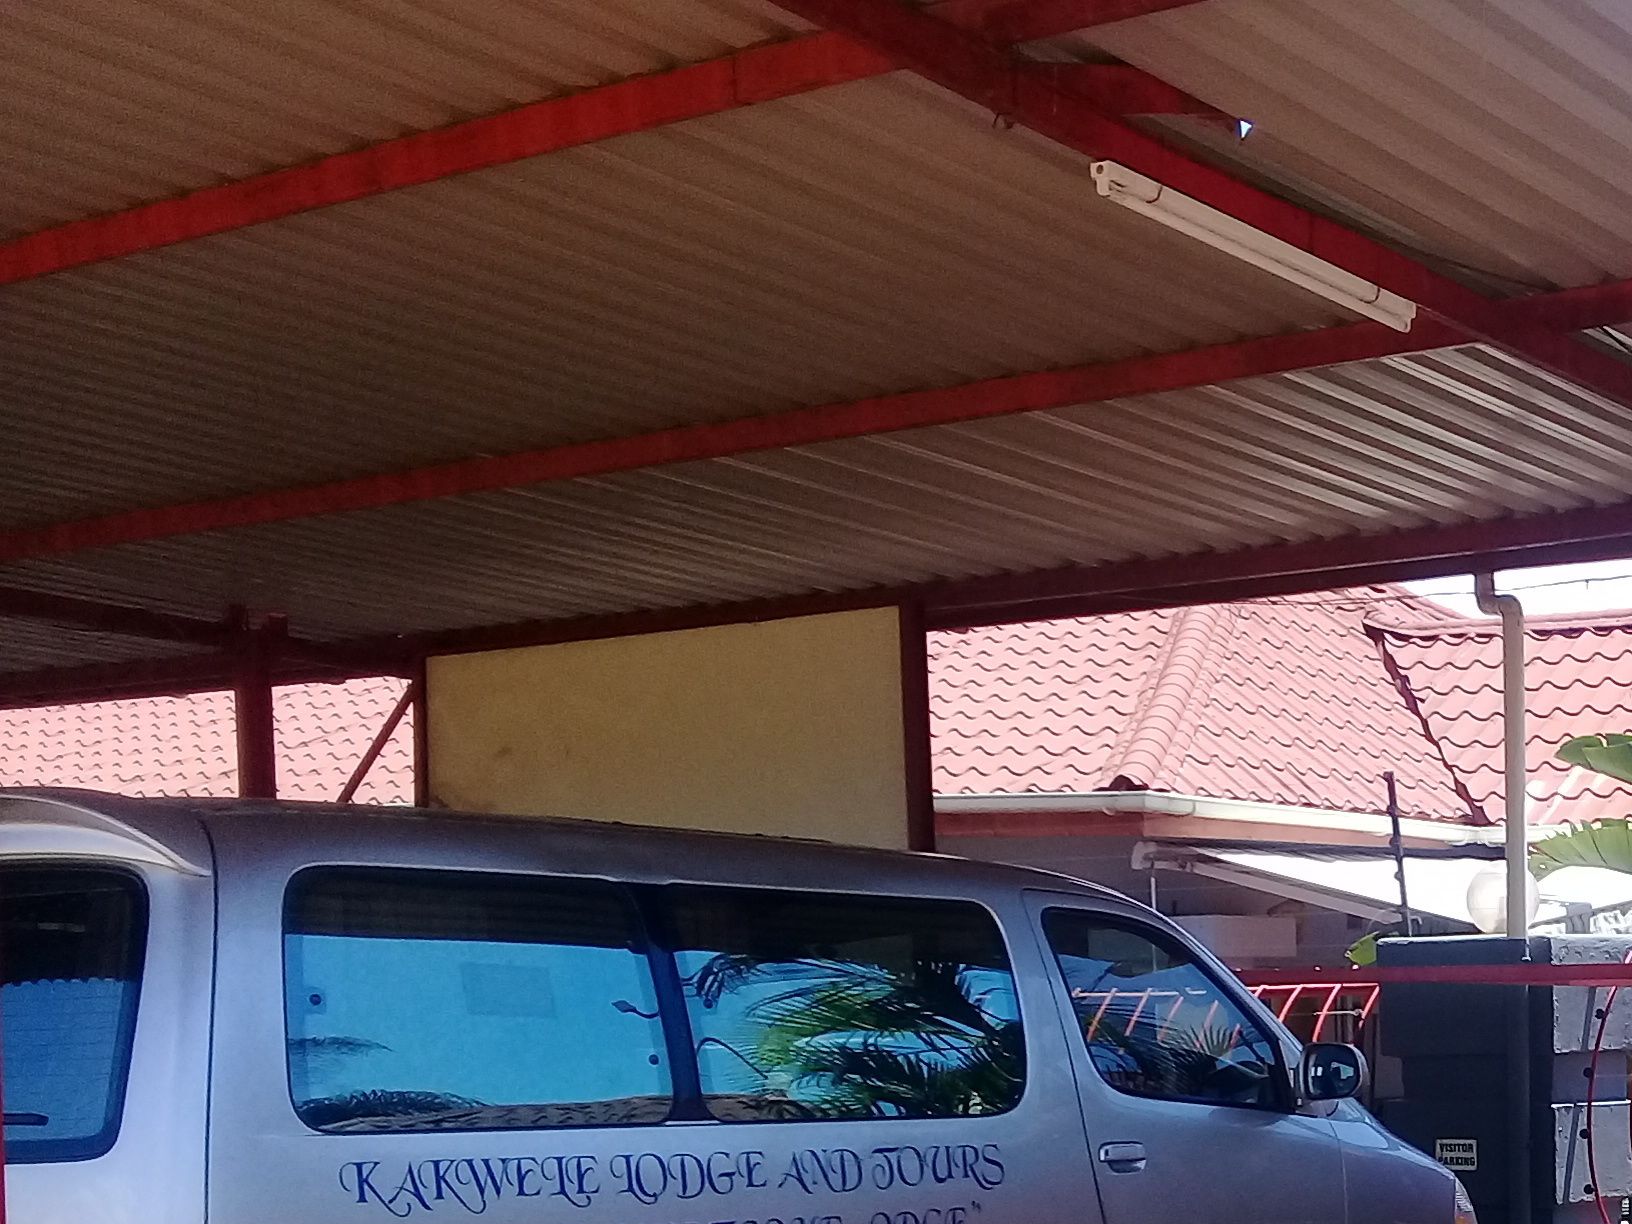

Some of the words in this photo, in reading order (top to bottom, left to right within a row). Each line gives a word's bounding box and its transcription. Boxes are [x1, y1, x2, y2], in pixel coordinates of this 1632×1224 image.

[1438, 1143, 1474, 1153] VISITOR
[339, 1155, 600, 1217] KAKWELE
[610, 1151, 768, 1205] LODGE
[778, 1148, 863, 1195] AND
[871, 1143, 1006, 1190] TOURS
